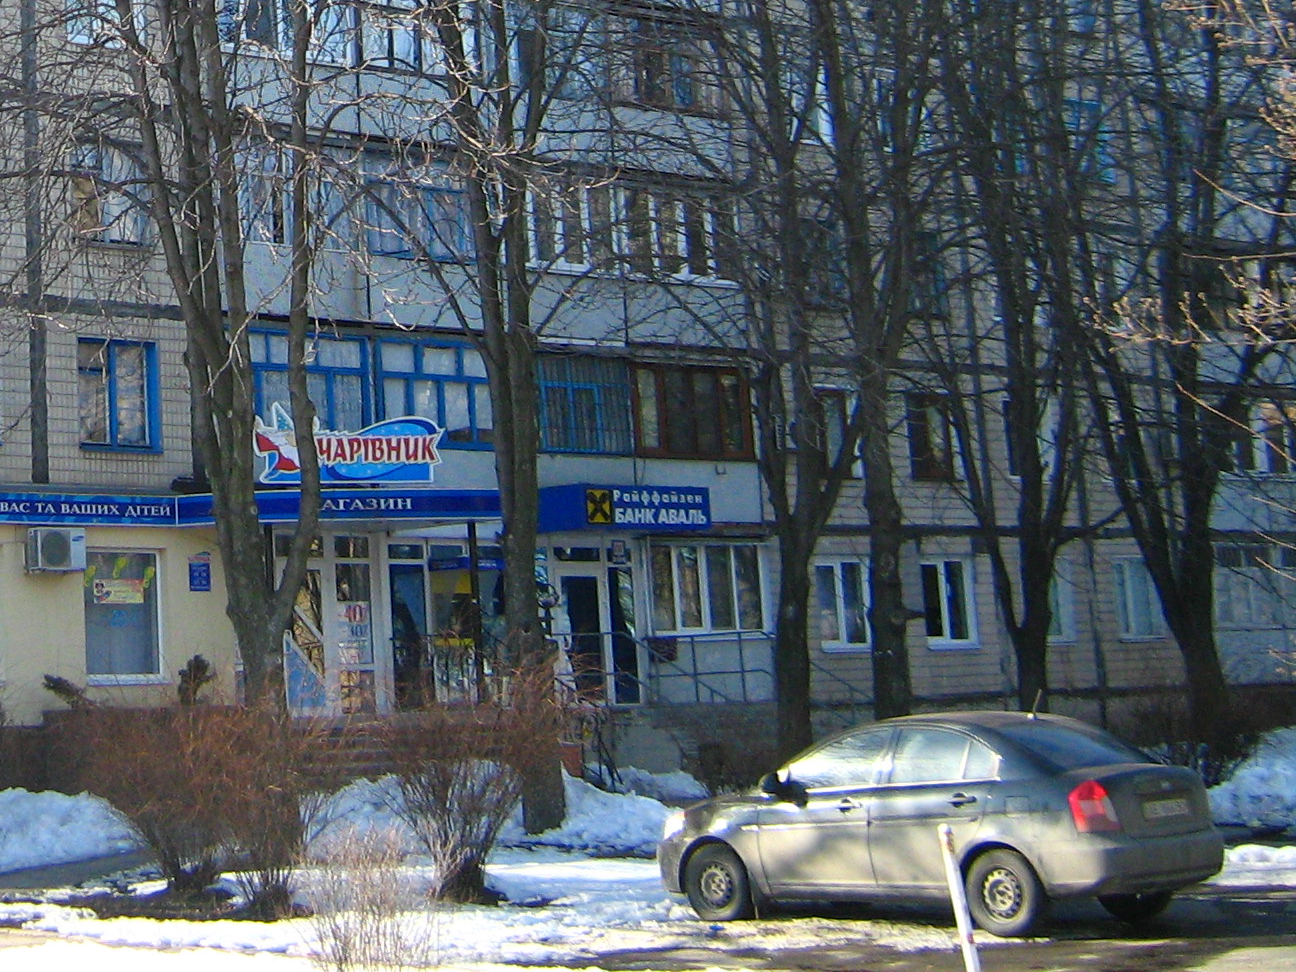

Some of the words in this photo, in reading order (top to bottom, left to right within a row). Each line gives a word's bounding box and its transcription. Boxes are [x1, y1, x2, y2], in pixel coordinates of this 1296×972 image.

[316, 436, 437, 463] ЧАРІВНИК
[319, 497, 413, 511] АГАЗИН
[612, 489, 703, 506] Райффайзен
[0, 501, 31, 514] ВАС
[35, 502, 55, 514] ТА
[61, 502, 120, 516] ВАШИХ
[125, 504, 171, 518] ДІТЕЙ
[614, 508, 655, 524] БАНК
[657, 508, 707, 525] АВАЛЬ
